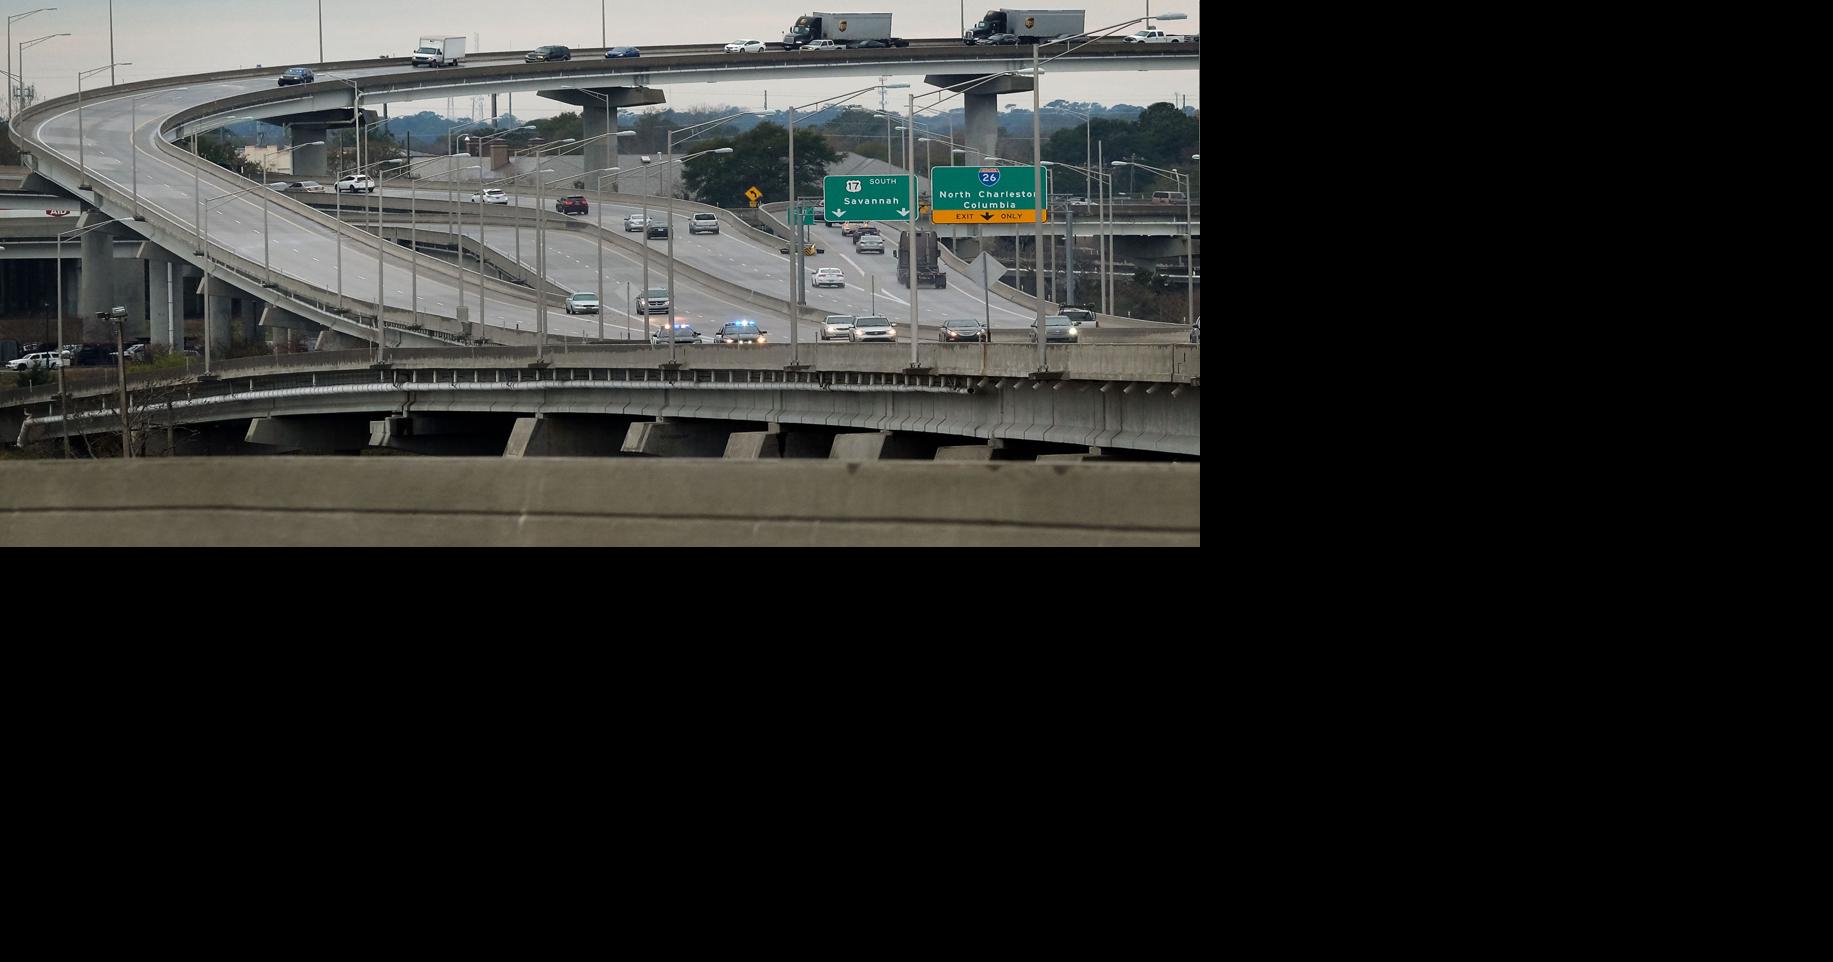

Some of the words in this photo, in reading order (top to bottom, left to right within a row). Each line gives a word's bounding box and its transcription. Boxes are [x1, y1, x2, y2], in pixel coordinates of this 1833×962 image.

[982, 173, 997, 182] 26
[848, 182, 859, 190] 17
[844, 197, 899, 205] Savannah
[963, 201, 1016, 209] Columbia
